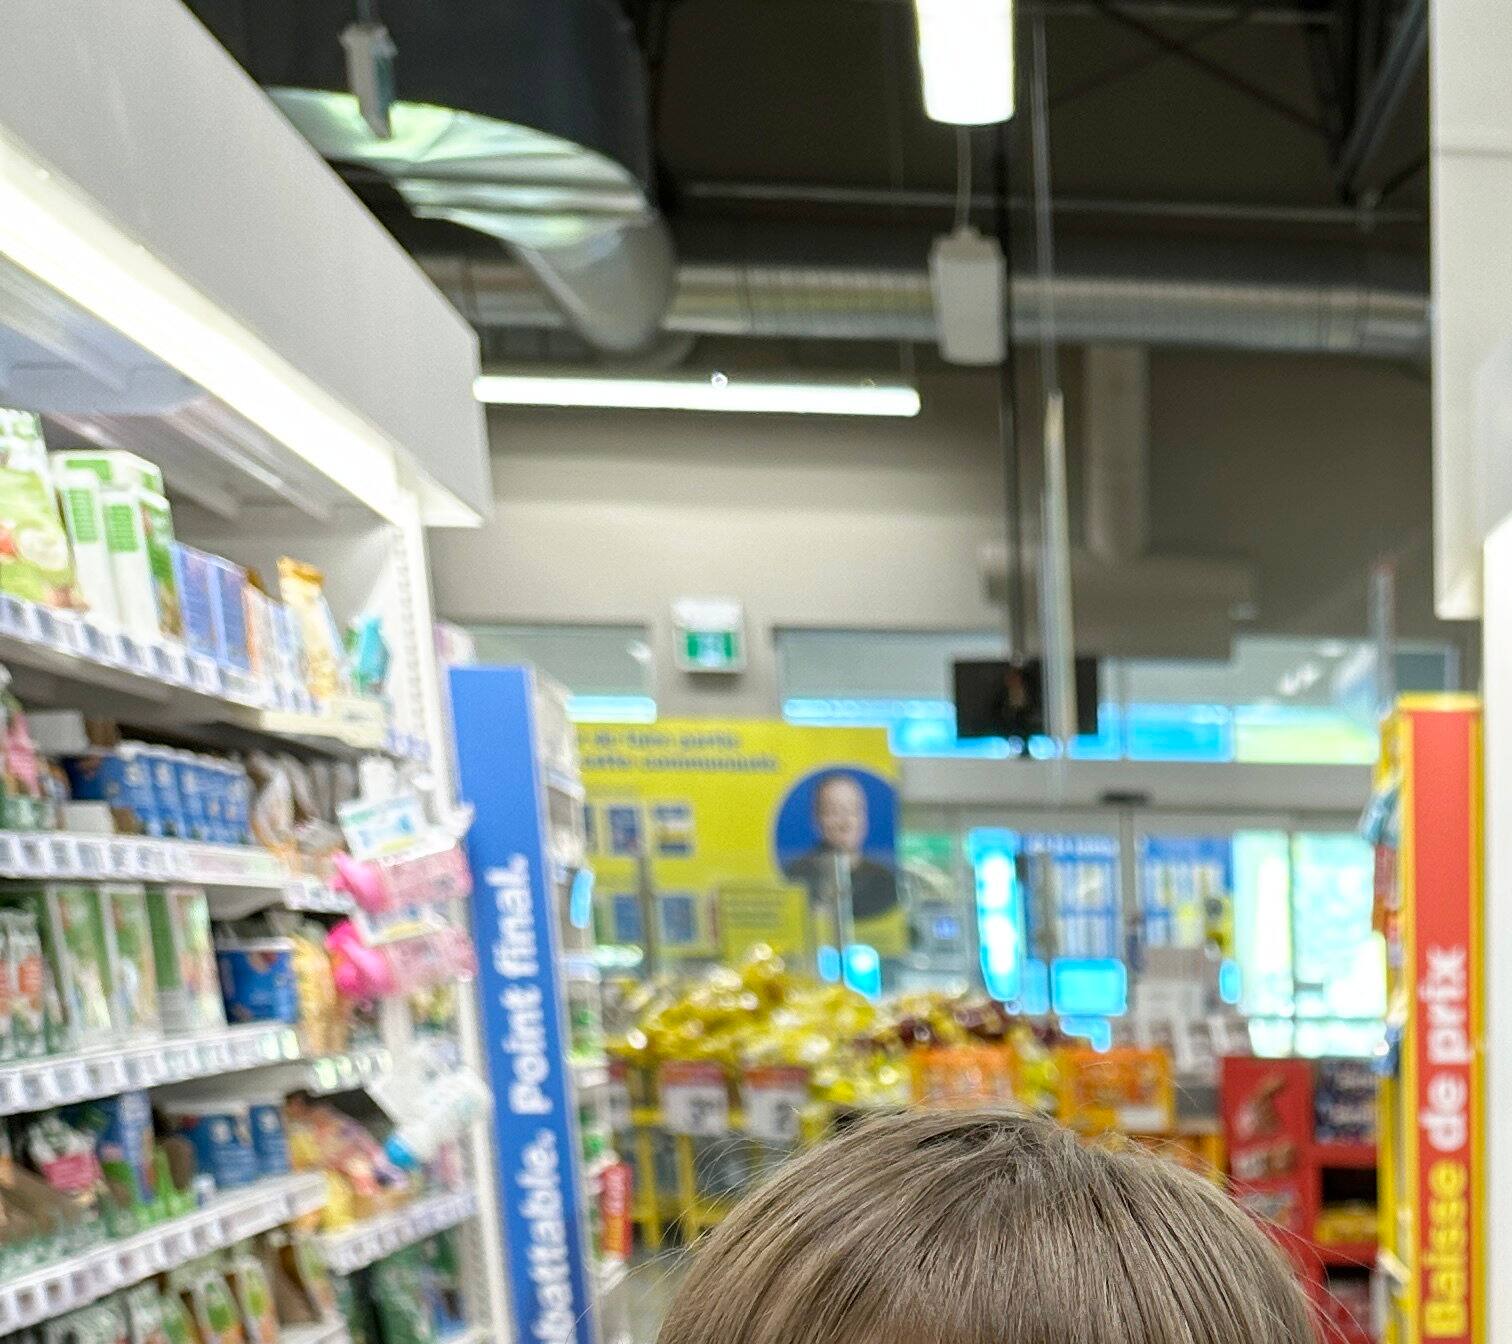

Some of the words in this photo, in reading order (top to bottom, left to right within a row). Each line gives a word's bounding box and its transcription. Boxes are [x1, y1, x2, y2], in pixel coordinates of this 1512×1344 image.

[485, 853, 539, 979] final.
[499, 982, 554, 1114] point
[1418, 945, 1475, 1064] prix
[1419, 1070, 1467, 1152] de
[1424, 1160, 1467, 1337] Baisse
